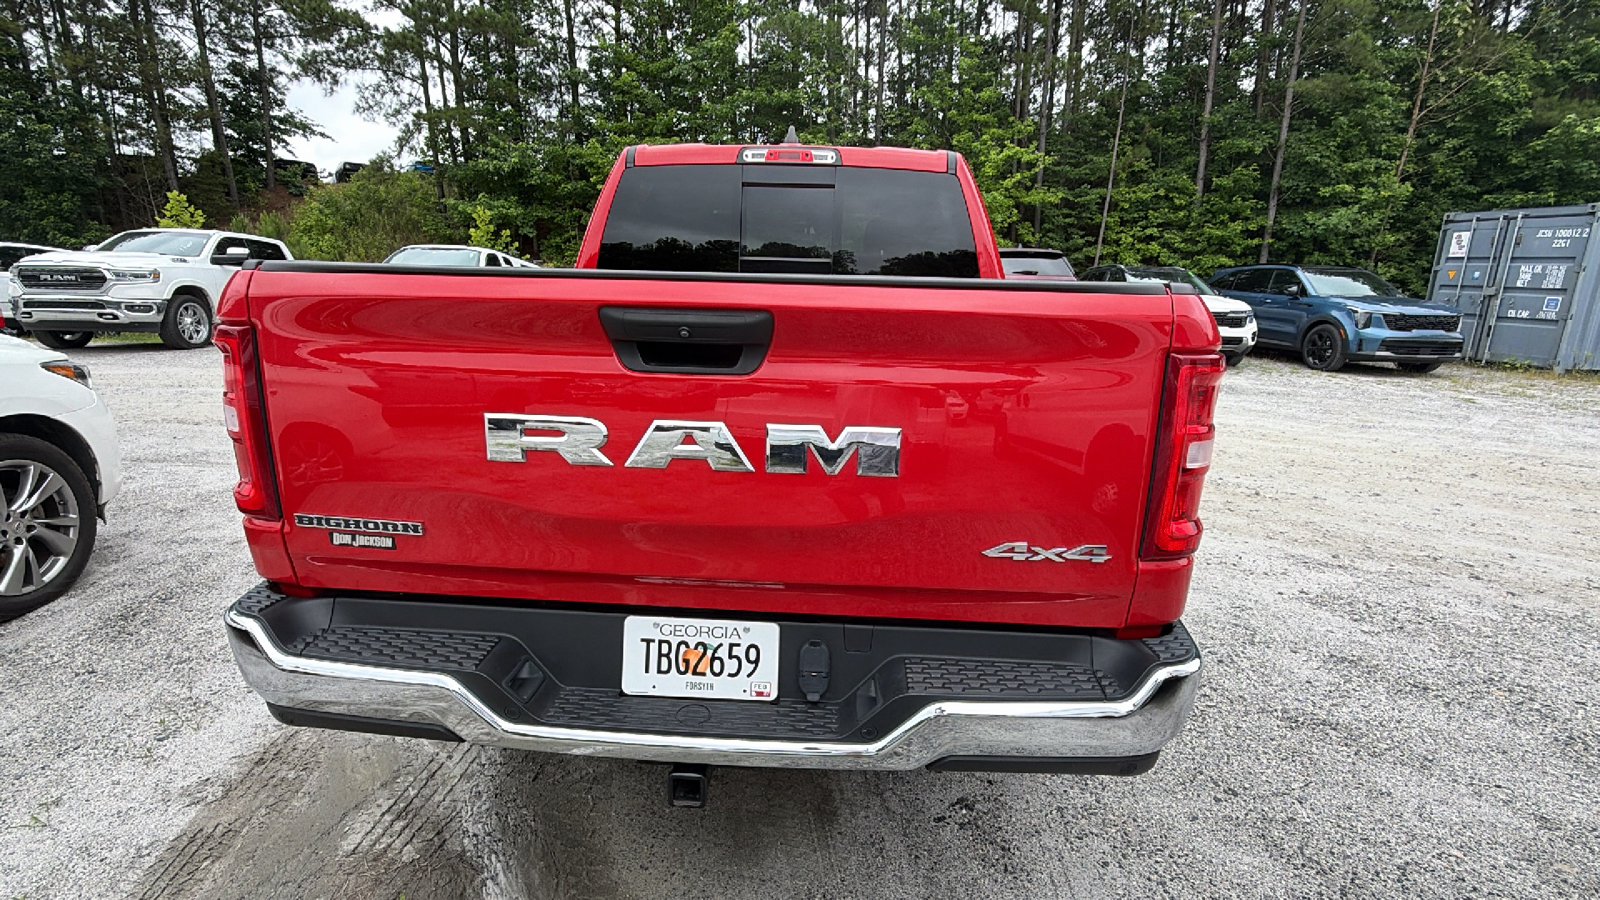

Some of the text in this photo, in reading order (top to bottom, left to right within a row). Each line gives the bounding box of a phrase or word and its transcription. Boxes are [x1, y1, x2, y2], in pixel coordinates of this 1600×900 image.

[1582, 228, 1590, 238] 2
[39, 274, 77, 282] RAM
[483, 412, 902, 478] RAM
[293, 512, 424, 536] BIGHORN
[659, 622, 742, 640] GEORGIA
[640, 637, 761, 679] TBG2659
[685, 681, 715, 692] FORSYTH
